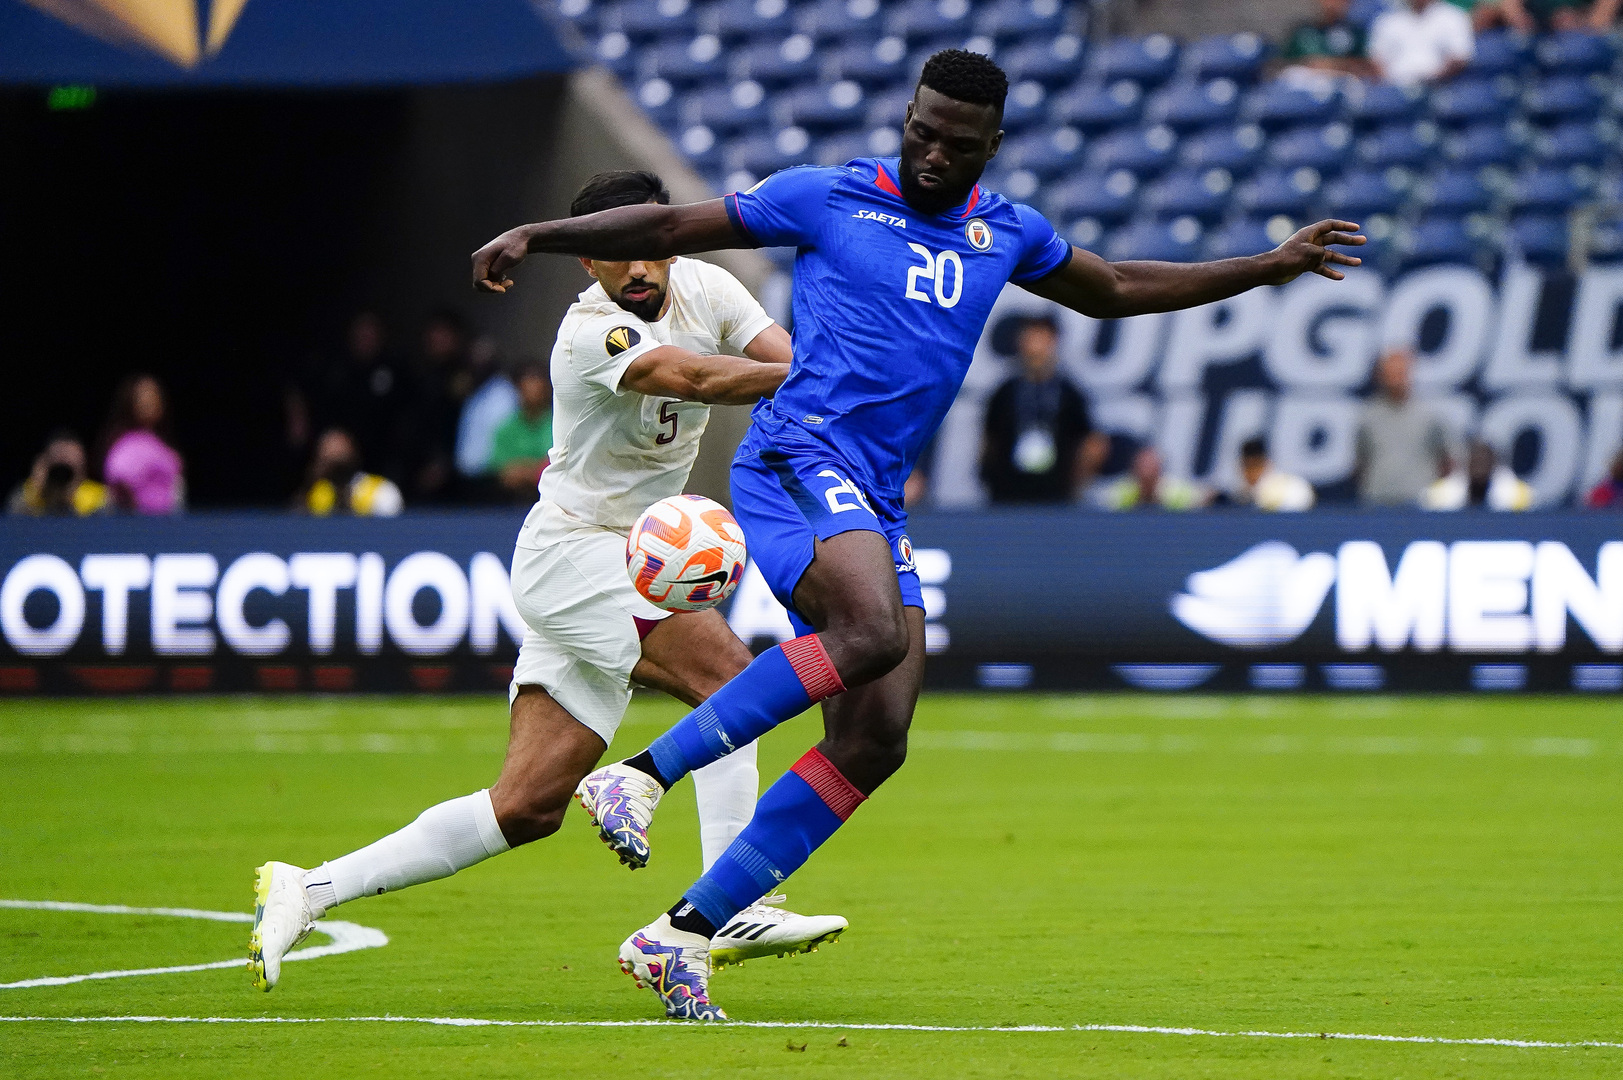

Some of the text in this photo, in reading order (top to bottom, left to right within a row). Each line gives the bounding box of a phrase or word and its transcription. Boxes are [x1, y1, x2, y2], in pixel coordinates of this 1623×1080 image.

[852, 209, 907, 229] SAETA
[905, 241, 964, 308] 20
[656, 400, 685, 444] 5
[1335, 539, 1623, 655] MEN
